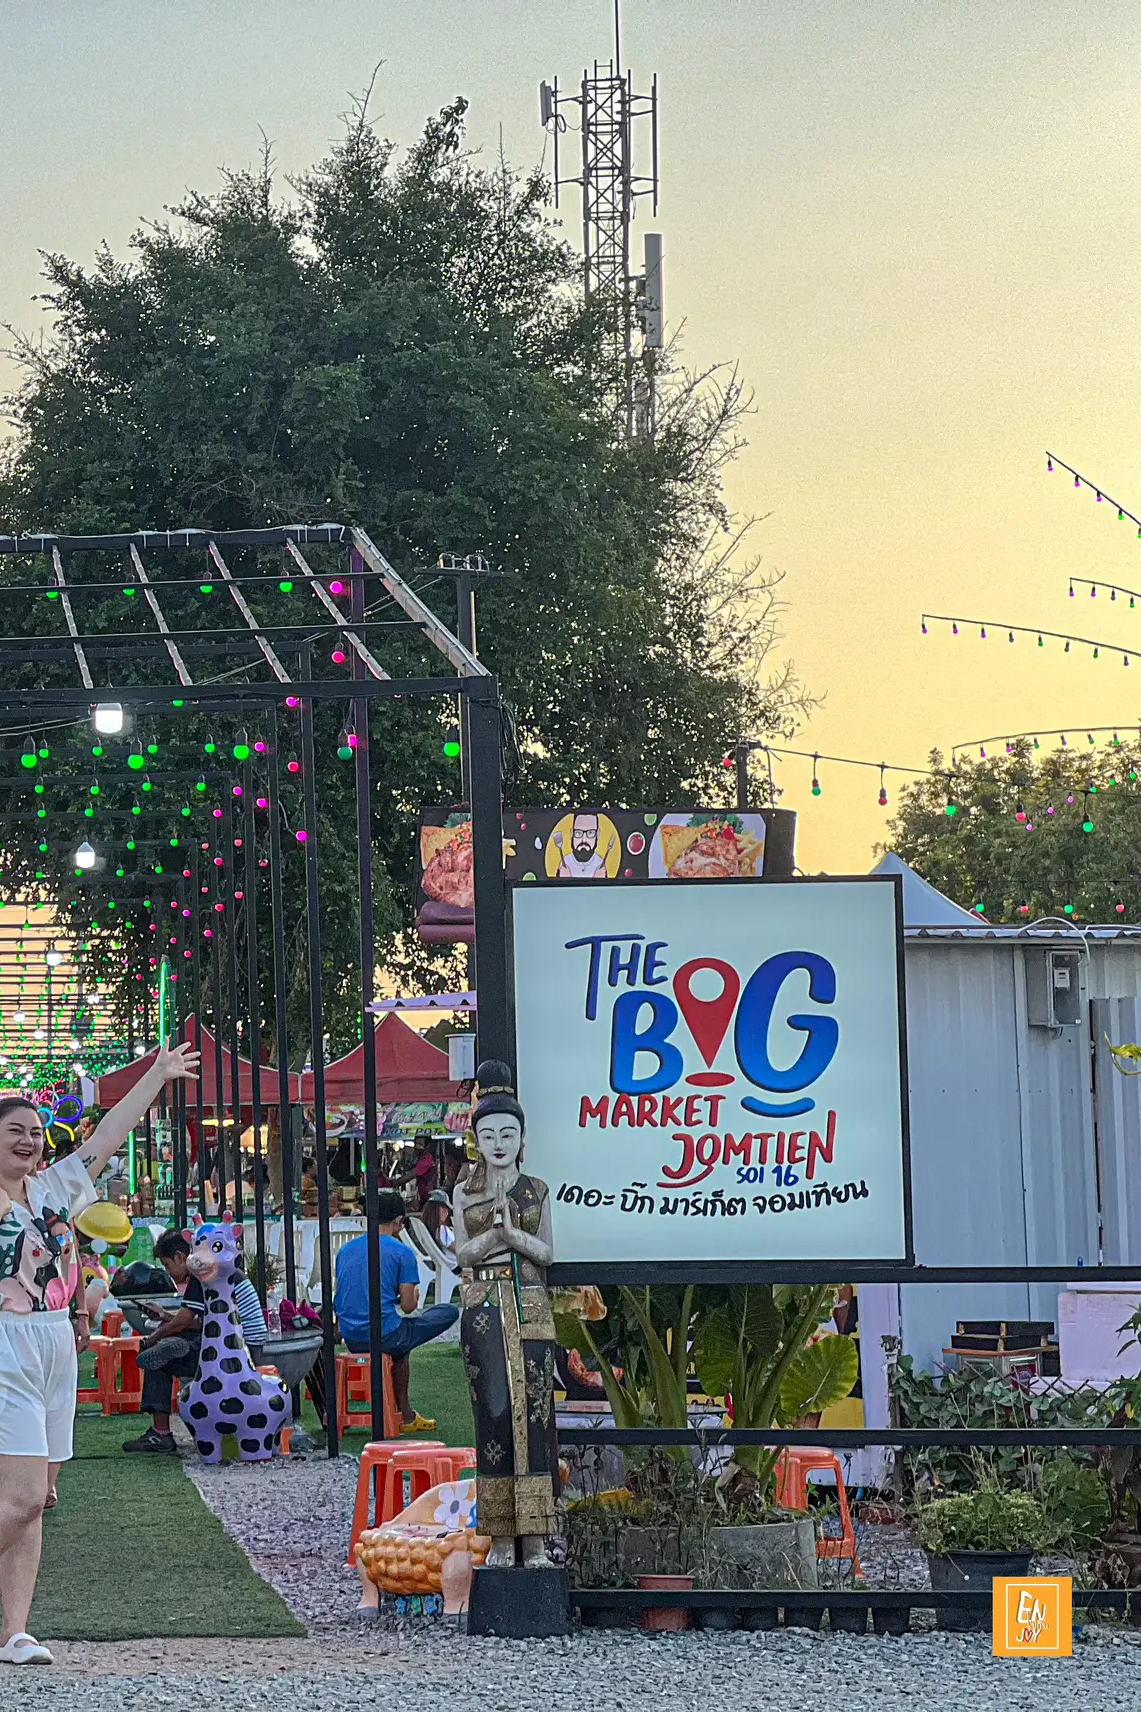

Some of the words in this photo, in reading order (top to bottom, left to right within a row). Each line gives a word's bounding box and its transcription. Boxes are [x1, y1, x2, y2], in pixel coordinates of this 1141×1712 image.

[564, 934, 669, 1021] THE
[578, 1093, 726, 1129] MARKET
[657, 1110, 837, 1188] JOMTIEN
[736, 1166, 765, 1184] SOI
[771, 1164, 799, 1187] 16
[556, 1183, 615, 1207] เดอะ
[620, 1182, 655, 1214] บิ๊ก
[659, 1190, 746, 1216] มาร์เก็ต
[752, 1180, 869, 1214] จอมเทียน
